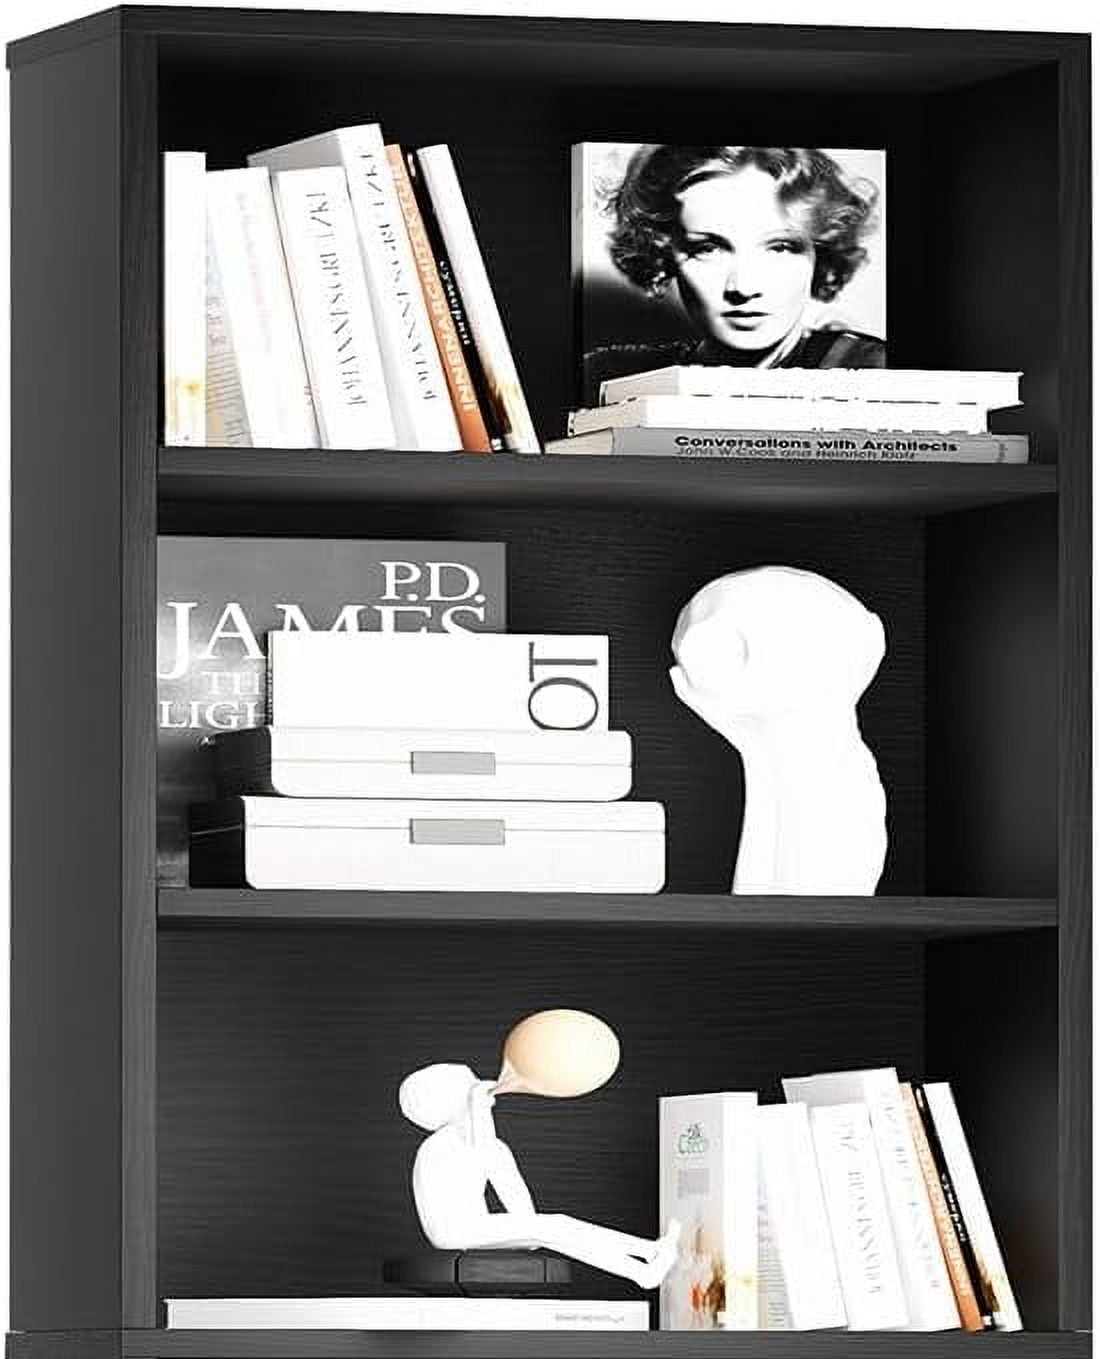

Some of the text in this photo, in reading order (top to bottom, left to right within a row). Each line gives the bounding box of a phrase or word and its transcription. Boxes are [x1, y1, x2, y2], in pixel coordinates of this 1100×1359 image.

[674, 434, 958, 452] Conversations with Architects
[379, 561, 486, 604] P.D.
